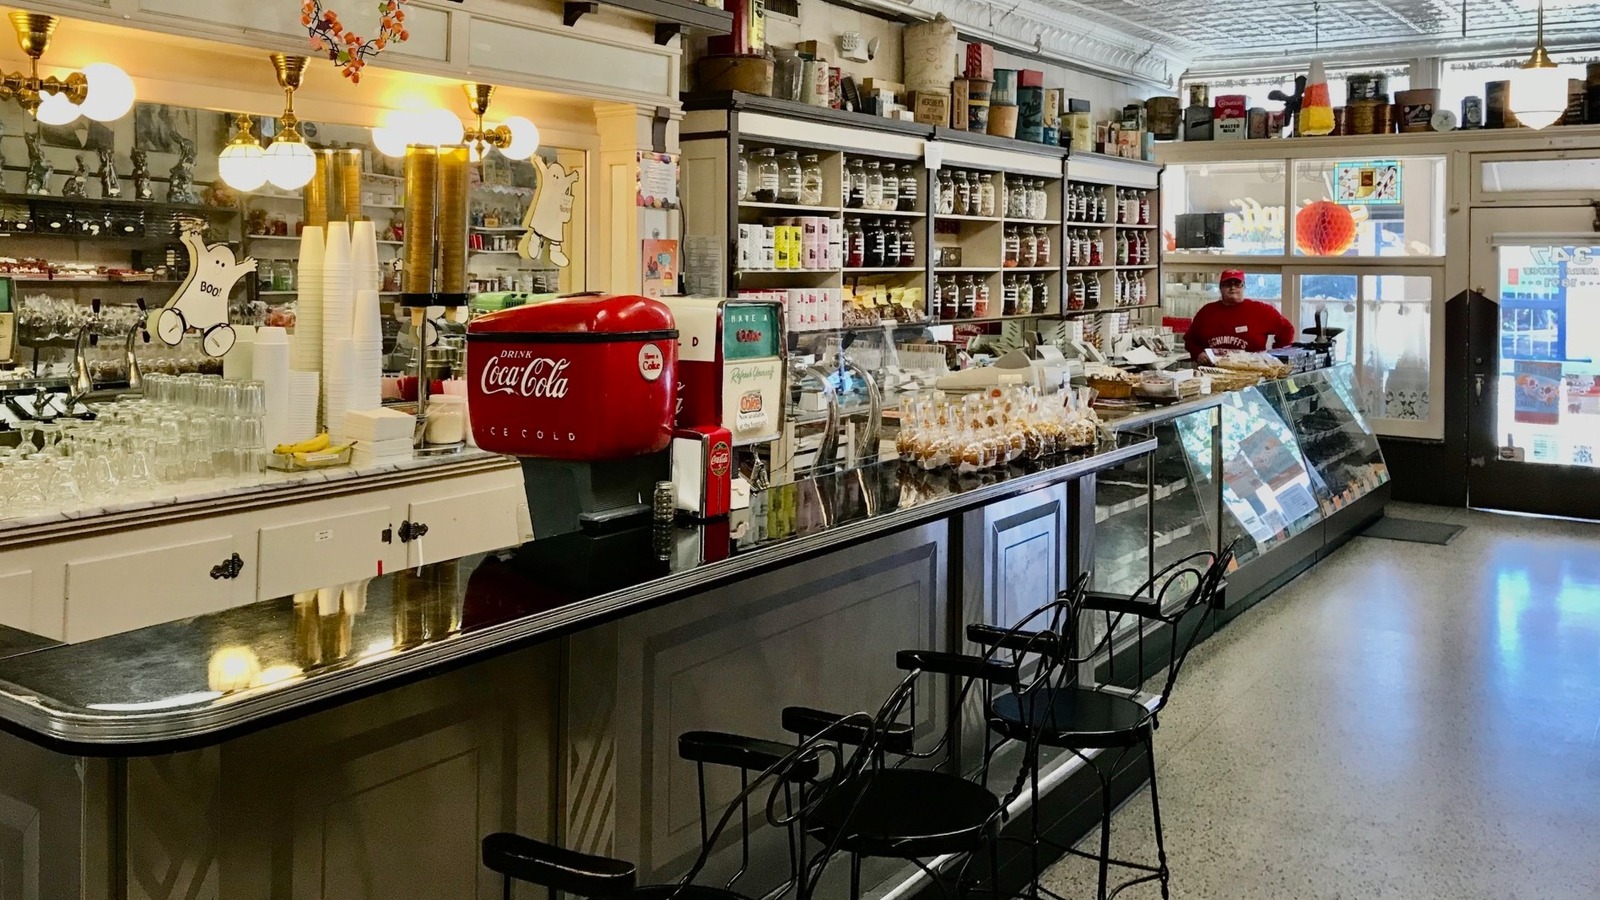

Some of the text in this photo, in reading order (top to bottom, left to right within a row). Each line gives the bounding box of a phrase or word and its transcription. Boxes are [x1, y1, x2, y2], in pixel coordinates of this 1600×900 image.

[200, 281, 222, 297] BOO!
[731, 313, 768, 323] HAVE A
[1208, 336, 1248, 350] SCHIMPFF'S
[500, 350, 533, 359] DRINK
[643, 360, 660, 371] Coke
[482, 426, 576, 441] CE COLD
